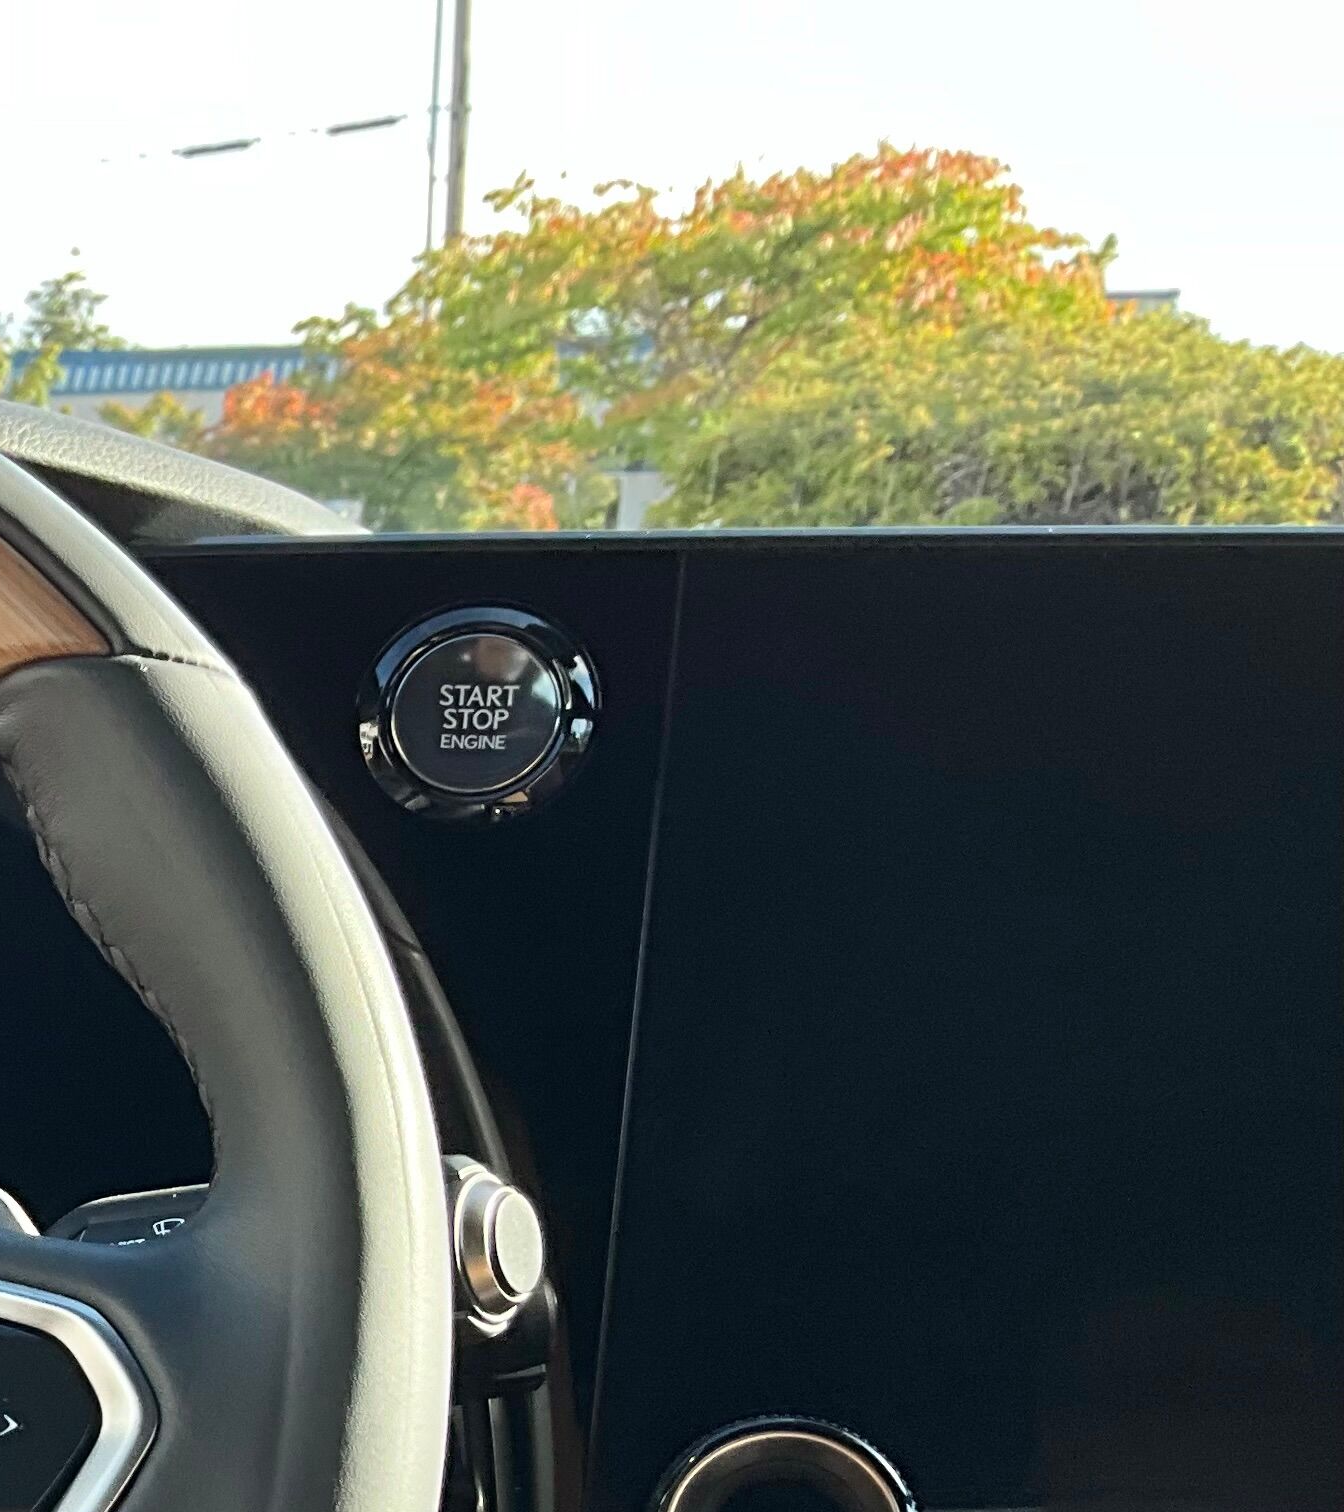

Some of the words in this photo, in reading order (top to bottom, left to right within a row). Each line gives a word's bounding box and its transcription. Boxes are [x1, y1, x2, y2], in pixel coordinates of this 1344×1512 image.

[439, 684, 521, 707] START
[442, 708, 510, 730] STOP
[439, 733, 508, 750] ENGINE
